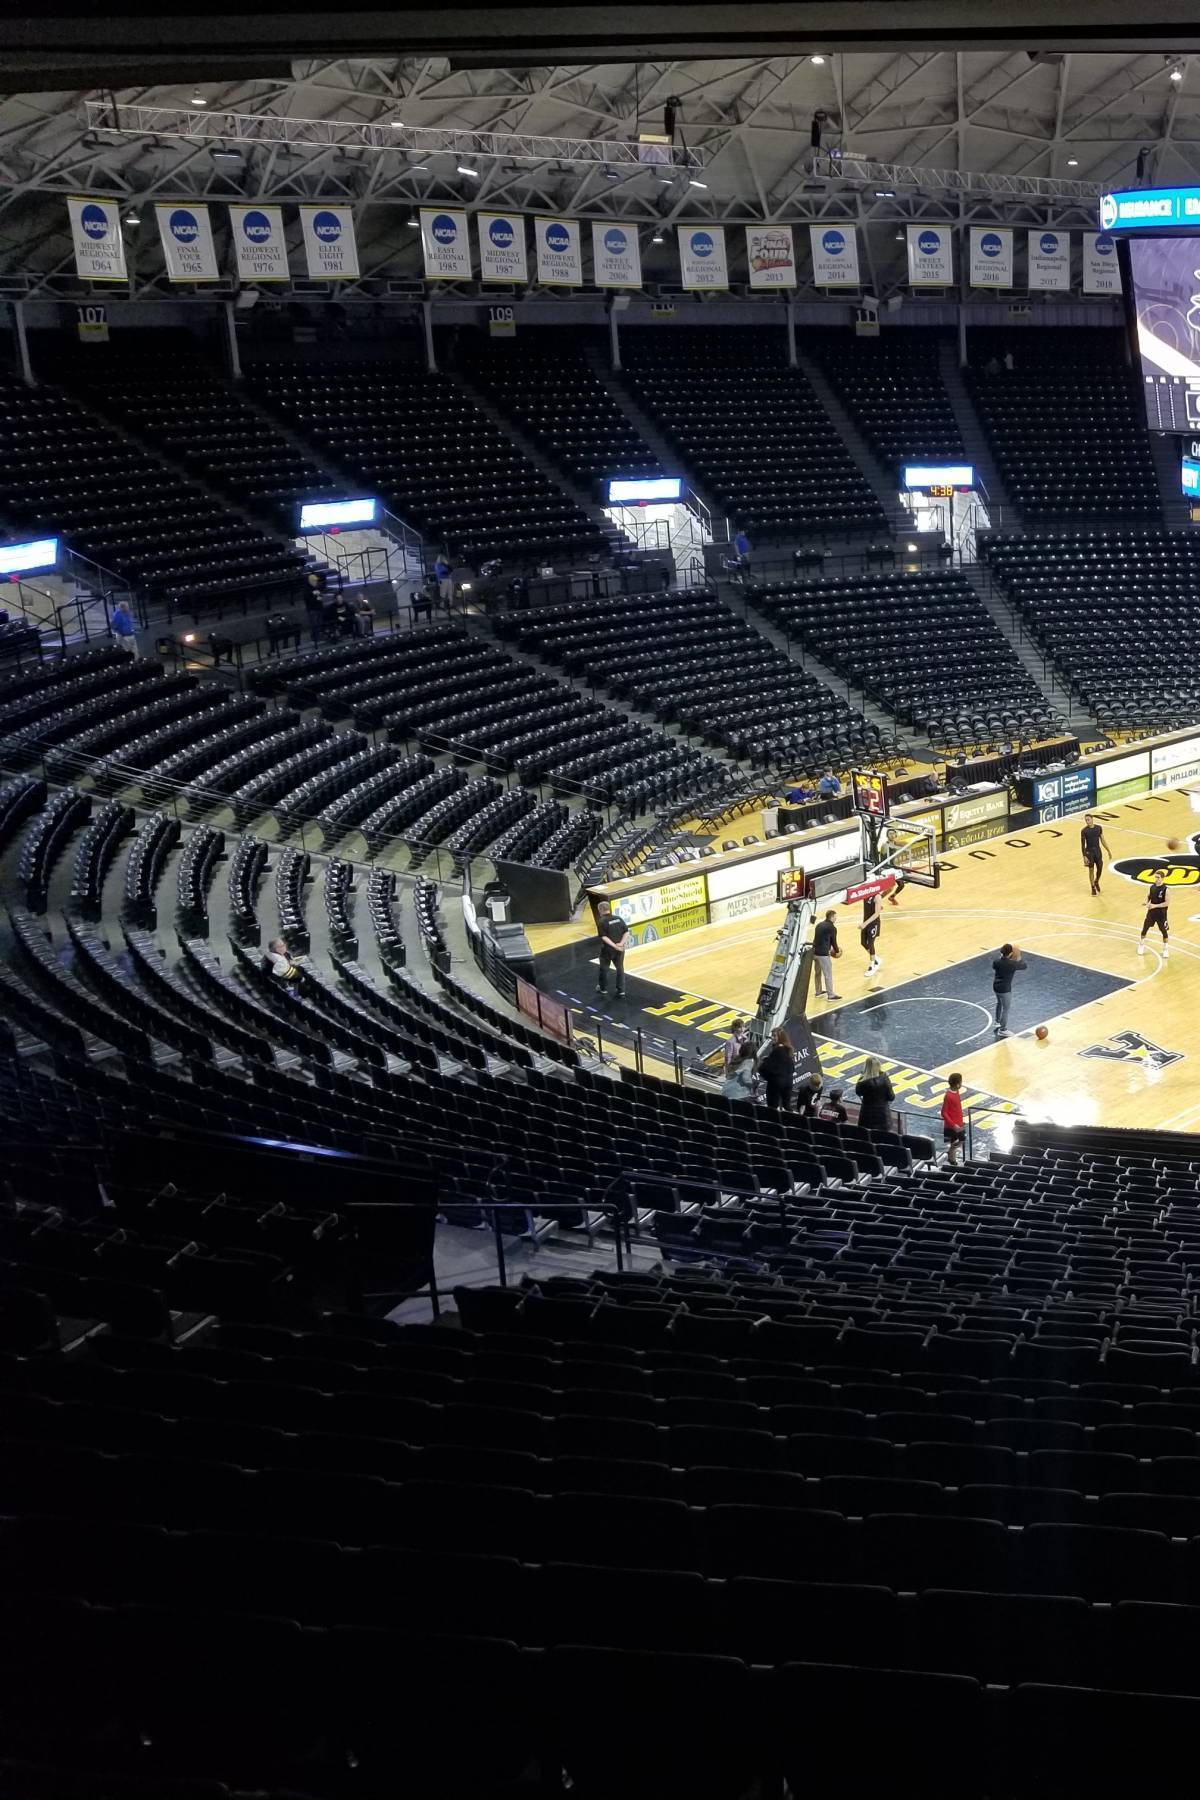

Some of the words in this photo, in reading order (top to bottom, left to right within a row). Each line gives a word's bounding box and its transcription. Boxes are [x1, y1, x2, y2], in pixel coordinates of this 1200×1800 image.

[760, 237, 789, 249] FINAL
[80, 249, 121, 259] REGIONAL
[241, 253, 282, 261] REGIONAL
[428, 253, 465, 261] REGIONAL
[751, 248, 789, 261] FOUR
[91, 259, 113, 272] 1964
[182, 262, 203, 273] 1965
[253, 262, 274, 273] 1976
[323, 261, 344, 271] 1981
[439, 262, 458, 272] 1985
[495, 265, 514, 274] 1987
[765, 273, 784, 282] 2013
[828, 271, 846, 280] 2014
[922, 270, 940, 279] 2015
[982, 273, 1000, 281] 2016
[1095, 279, 1113, 288] 2018
[77, 307, 106, 323] 107
[489, 306, 514, 320] 109
[931, 485, 953, 496] 4:38
[960, 806, 985, 820] EQUITY
[985, 800, 1005, 813] BANK
[661, 888, 704, 906] BlueShield
